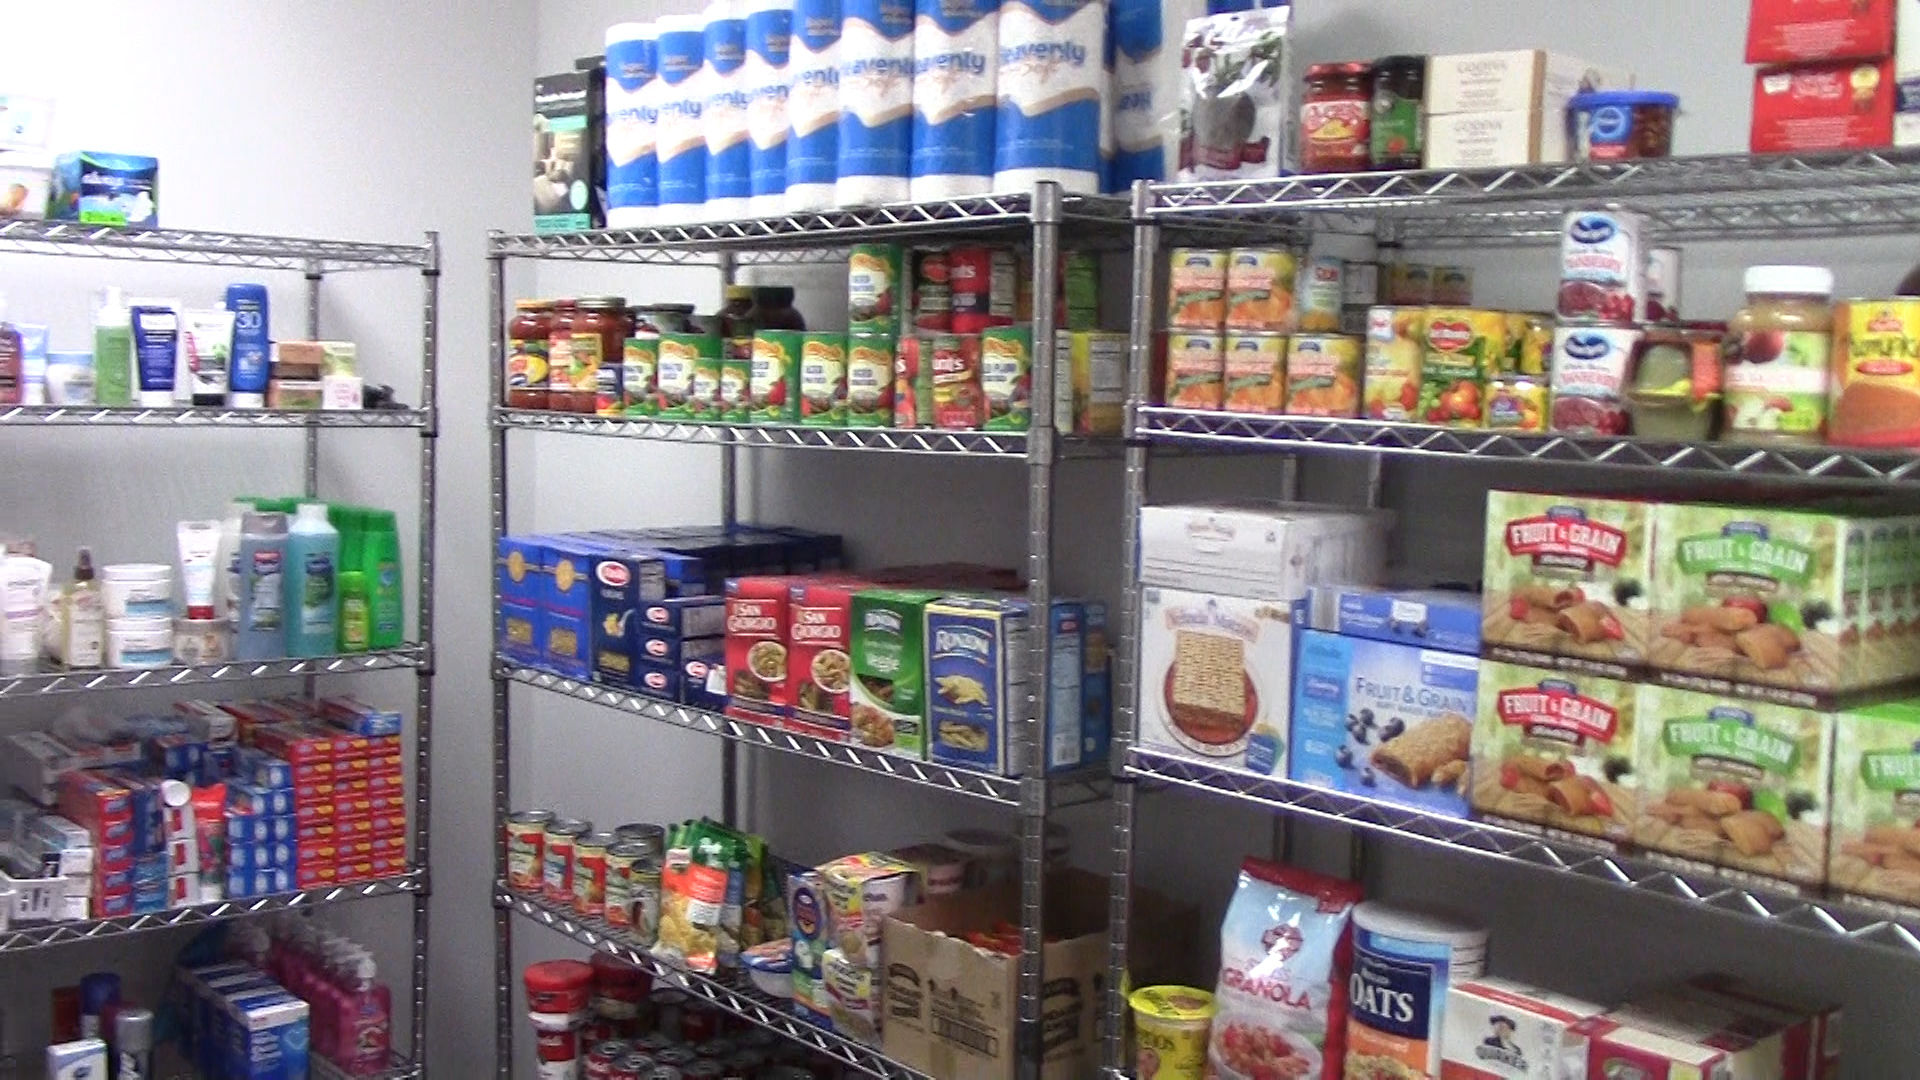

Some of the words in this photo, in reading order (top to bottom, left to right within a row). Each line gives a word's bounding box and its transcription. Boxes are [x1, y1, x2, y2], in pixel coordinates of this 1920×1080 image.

[236, 311, 262, 328] 30
[1511, 522, 1557, 547] FRUIT
[1569, 523, 1622, 556] GRAIN
[1502, 693, 1549, 714] FRUIT
[1560, 696, 1613, 732] GRAIN
[1223, 966, 1311, 1011] GRANOLA
[1349, 972, 1415, 1023] OATS
